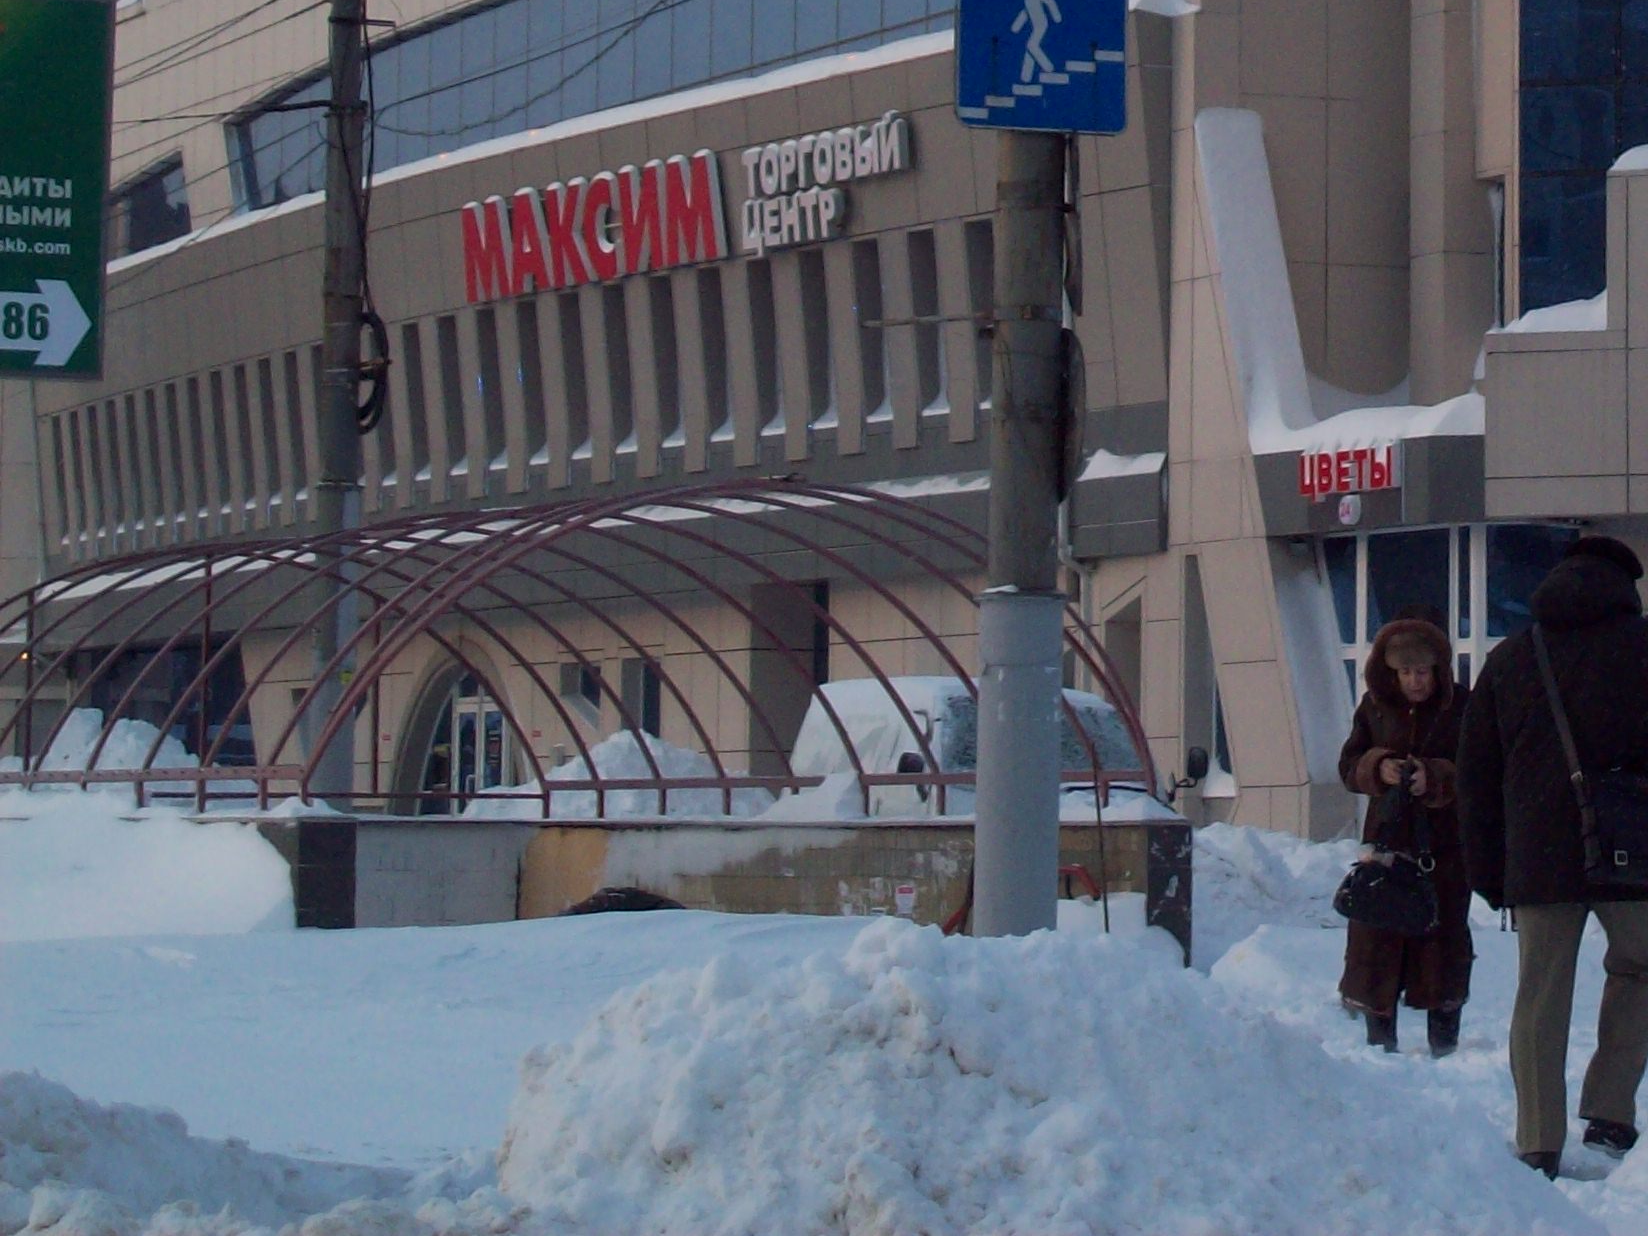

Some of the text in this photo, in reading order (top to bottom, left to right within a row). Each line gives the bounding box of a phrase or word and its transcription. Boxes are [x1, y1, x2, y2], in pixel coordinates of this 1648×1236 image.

[741, 110, 908, 198] ТОРГОВЫЙ
[462, 150, 725, 304] МАКСИМ
[741, 185, 841, 258] ЦЕНТР
[3, 301, 50, 341] 86
[1299, 445, 1392, 503] ЦВЕТЫ
